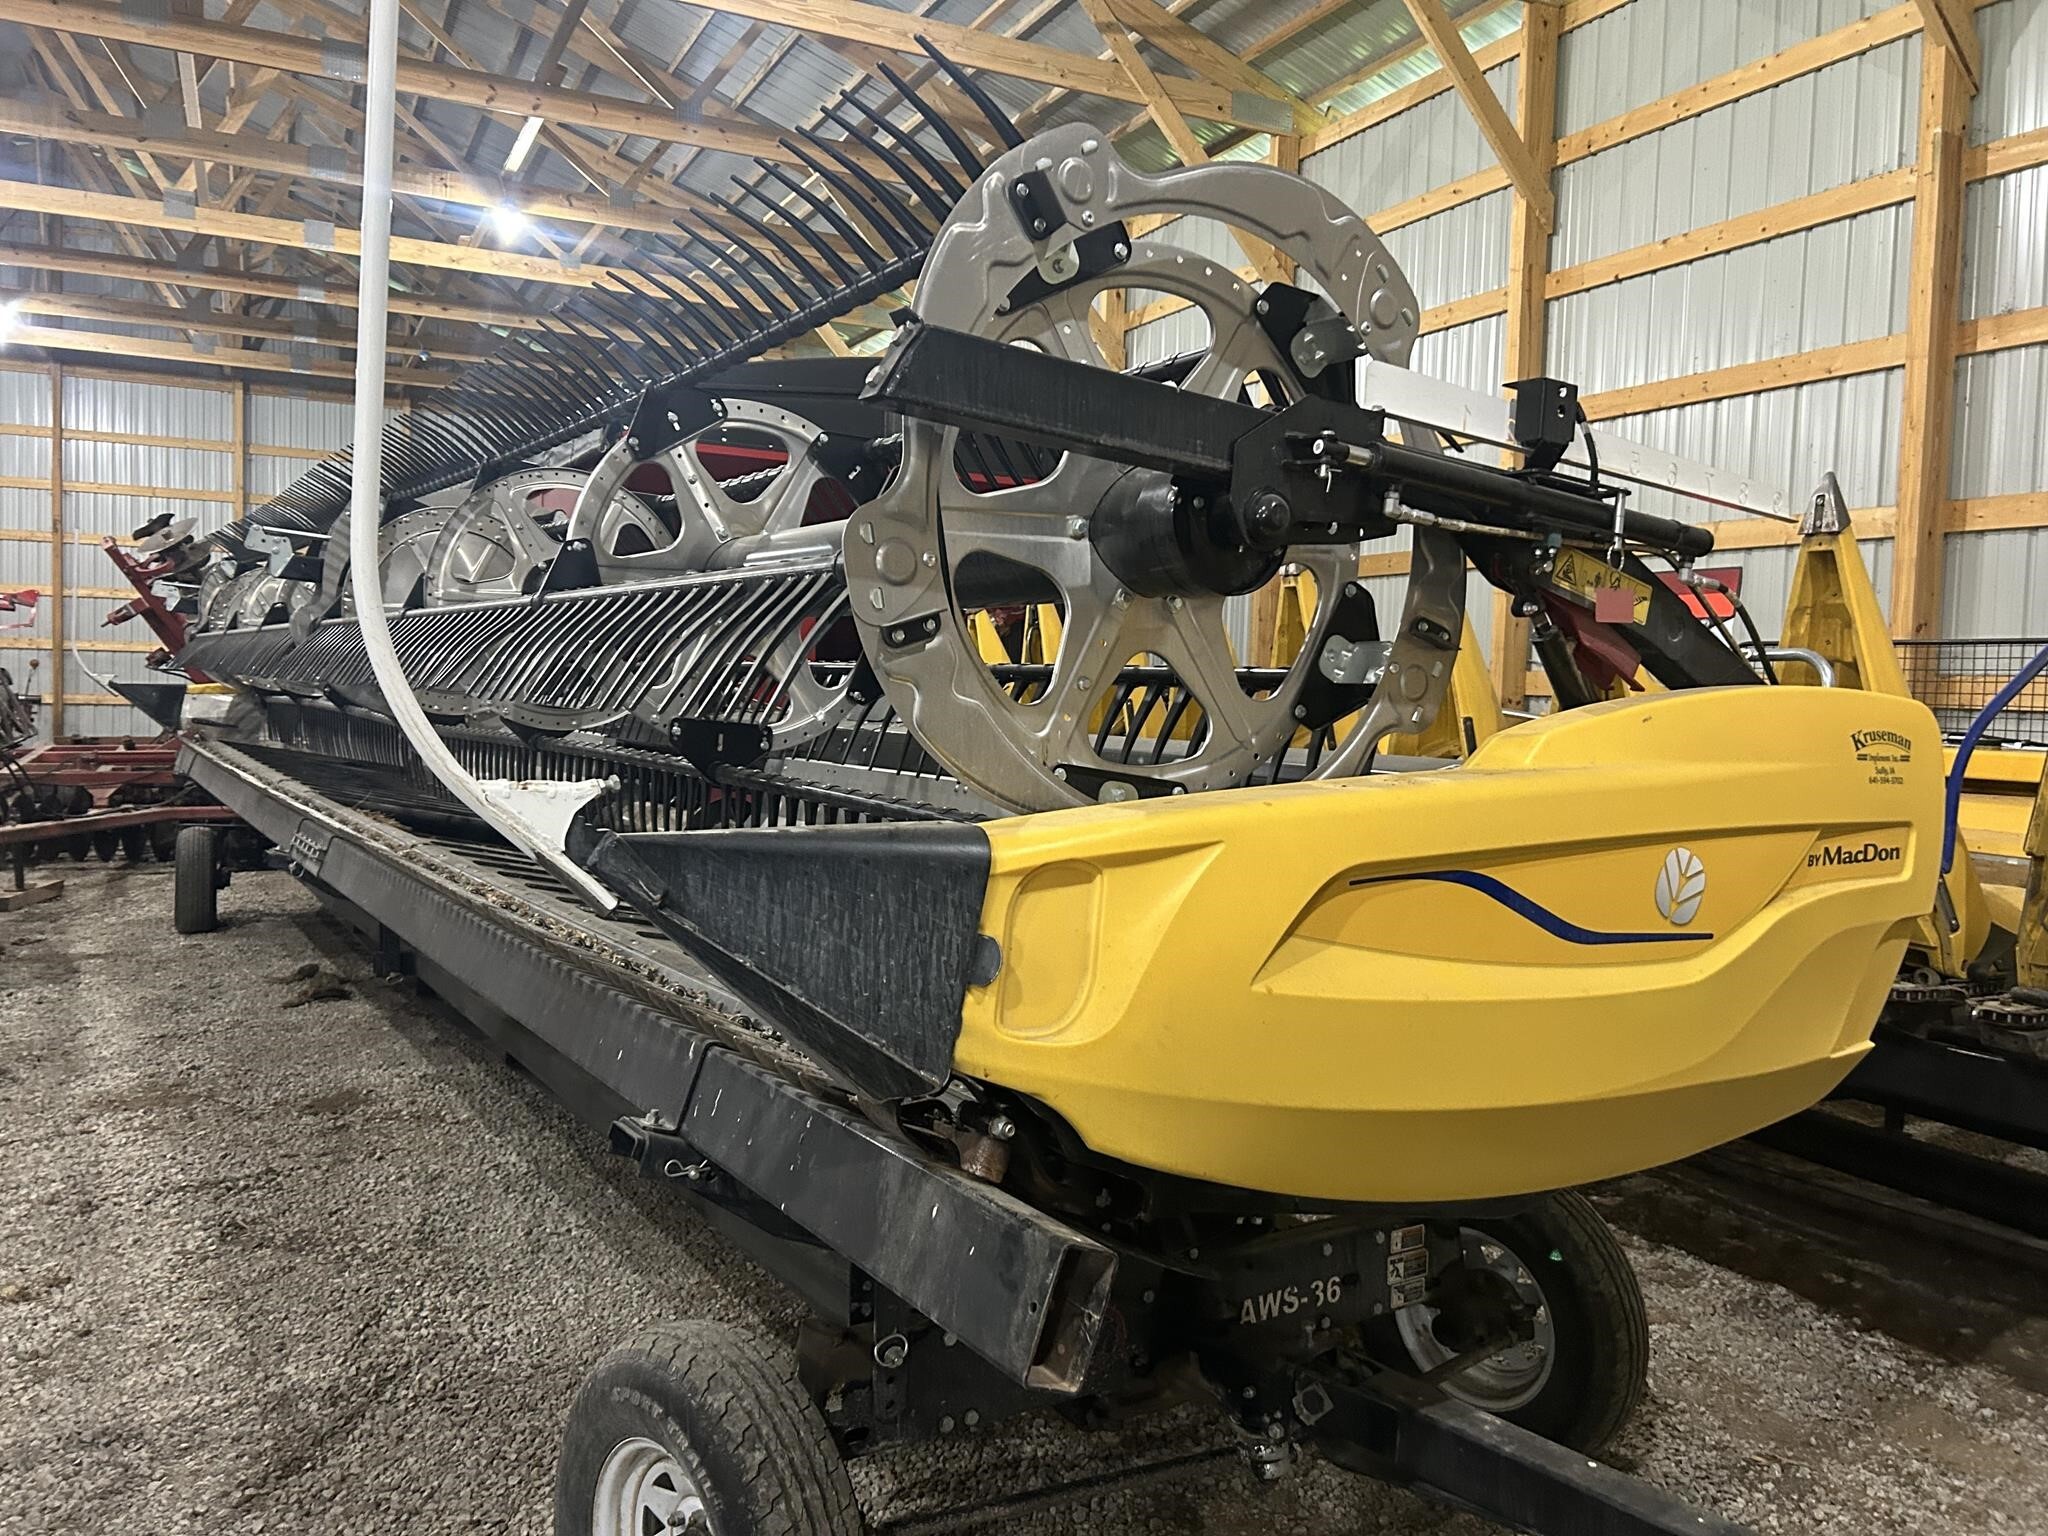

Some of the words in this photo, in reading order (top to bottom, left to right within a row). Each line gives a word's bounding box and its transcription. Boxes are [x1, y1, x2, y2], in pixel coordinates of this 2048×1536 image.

[1851, 730, 1911, 752] Kruseman
[1807, 854, 1821, 867] BY
[1822, 843, 1901, 866] MacDon
[1240, 1275, 1342, 1325] AWS-36
